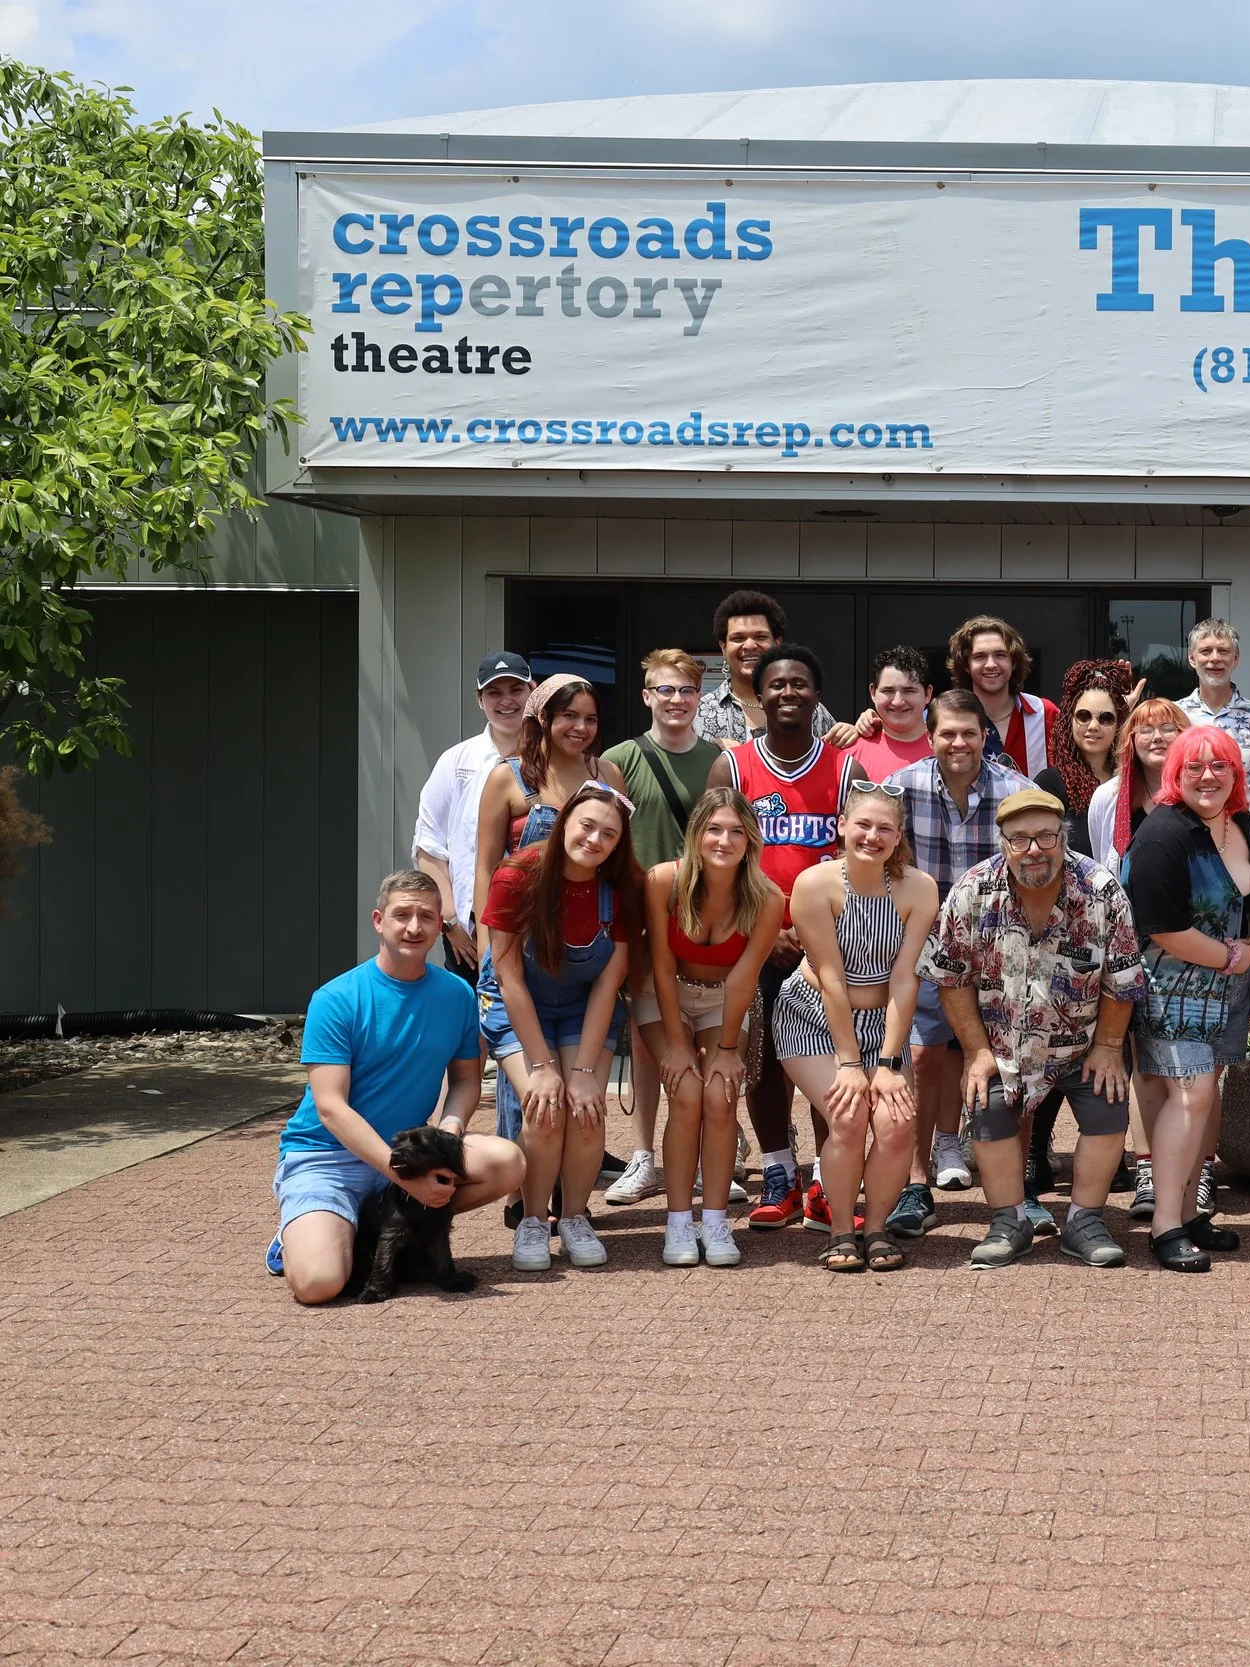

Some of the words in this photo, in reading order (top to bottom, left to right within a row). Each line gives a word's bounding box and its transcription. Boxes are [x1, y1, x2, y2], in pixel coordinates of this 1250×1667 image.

[331, 202, 773, 261] crossroads
[331, 262, 722, 336] repertory
[331, 331, 532, 376] theatre
[330, 411, 934, 458] www.crossroadsrep.com
[757, 815, 838, 842] NIGHTS
